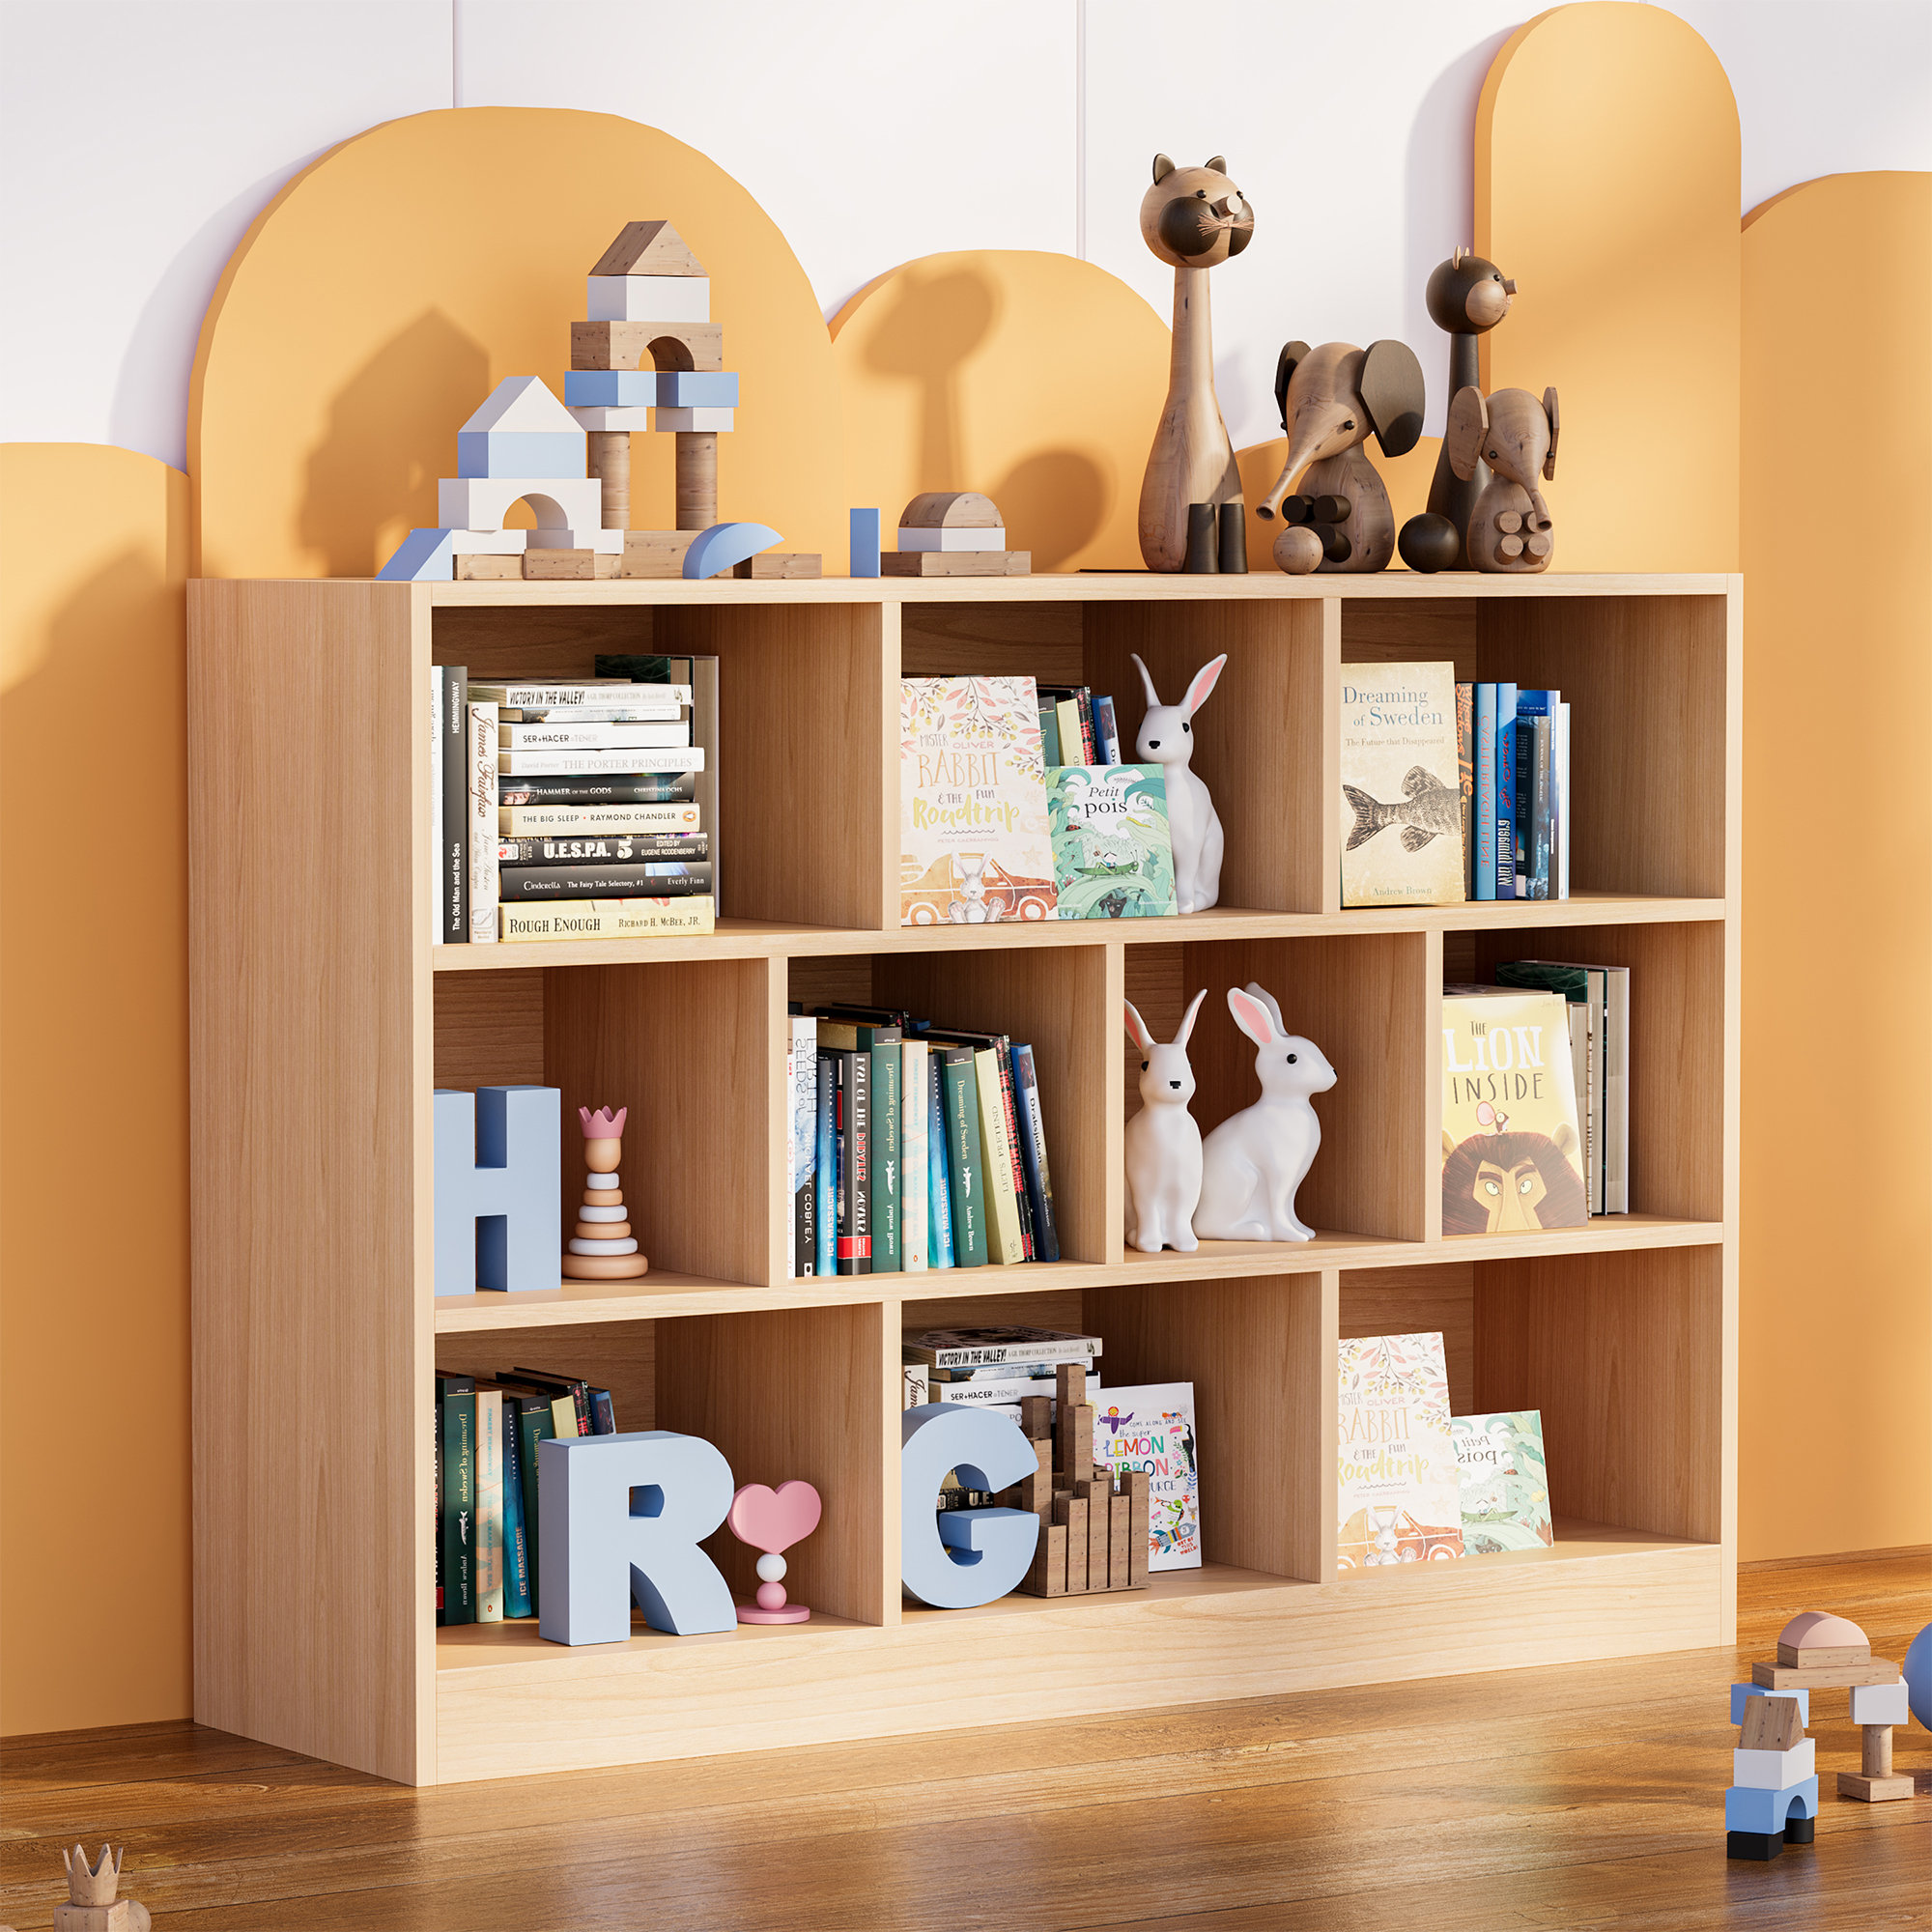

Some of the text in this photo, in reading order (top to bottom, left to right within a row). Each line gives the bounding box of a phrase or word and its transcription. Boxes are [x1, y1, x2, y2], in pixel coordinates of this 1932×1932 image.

[510, 692, 535, 705] VICTORY
[535, 692, 543, 705] IN
[545, 691, 557, 705] THE
[558, 690, 585, 705] VALLEY!
[1343, 686, 1429, 707] Dreaming
[1352, 706, 1443, 726] of Sweden
[1455, 684, 1465, 756] Shadows
[1462, 684, 1474, 736] Where
[471, 707, 496, 757] James
[920, 734, 949, 748] MISTER
[1080, 720, 1092, 742] THE
[952, 741, 995, 750] OLIVER
[1346, 738, 1359, 747] The
[1402, 736, 1445, 748] Disappeared
[562, 759, 585, 769] THE
[587, 759, 630, 769] PORTER
[632, 757, 693, 769] PRINCIPLES
[917, 750, 1001, 788] RABBIT
[947, 792, 963, 805] THE
[976, 789, 995, 801] FUN
[1088, 786, 1121, 798] Petit
[913, 794, 1020, 833] Roadtrip
[1084, 798, 1128, 818] pois
[543, 841, 611, 860] U.E.S.P.A.
[616, 840, 634, 860] 5
[524, 881, 560, 891] Cinderella
[580, 881, 594, 890] Fairy
[668, 877, 688, 886] Everly
[1372, 887, 1433, 896] Andrew Brown
[510, 918, 601, 933] ROUGH ENOUGH
[618, 918, 649, 927] RICHARD
[649, 918, 659, 927] H.
[688, 916, 701, 925] JR.
[1470, 1021, 1488, 1036] THE
[1443, 1026, 1545, 1072] LION
[1453, 1072, 1544, 1103] INSIDE
[956, 1080, 967, 1119] Dreaming
[991, 1105, 1005, 1157] PRETEND
[999, 1068, 1024, 1194] THE DOOMSDAY MACHINE
[1029, 1097, 1043, 1164] Draksjukan
[960, 1128, 970, 1160] Sweden
[433, 1085, 562, 1297] H
[939, 1179, 950, 1235] MASSACRE
[938, 1352, 962, 1366] VICTORY
[962, 1351, 970, 1365] IN
[970, 1350, 981, 1364] THE
[982, 1349, 1007, 1363] VALLEY!
[904, 1370, 927, 1408] Jam
[1367, 1397, 1406, 1406] OLIVER
[577, 1415, 589, 1435] THE
[1338, 1406, 1410, 1445] RABBIT
[1103, 1435, 1165, 1457] LEMON
[1362, 1449, 1376, 1460] THE
[1388, 1443, 1406, 1455] FUN
[1338, 1449, 1430, 1487] Roadtrip
[902, 1404, 1040, 1608] G
[539, 1431, 738, 1646] R
[515, 1526, 527, 1596] ICE MASSACRE
